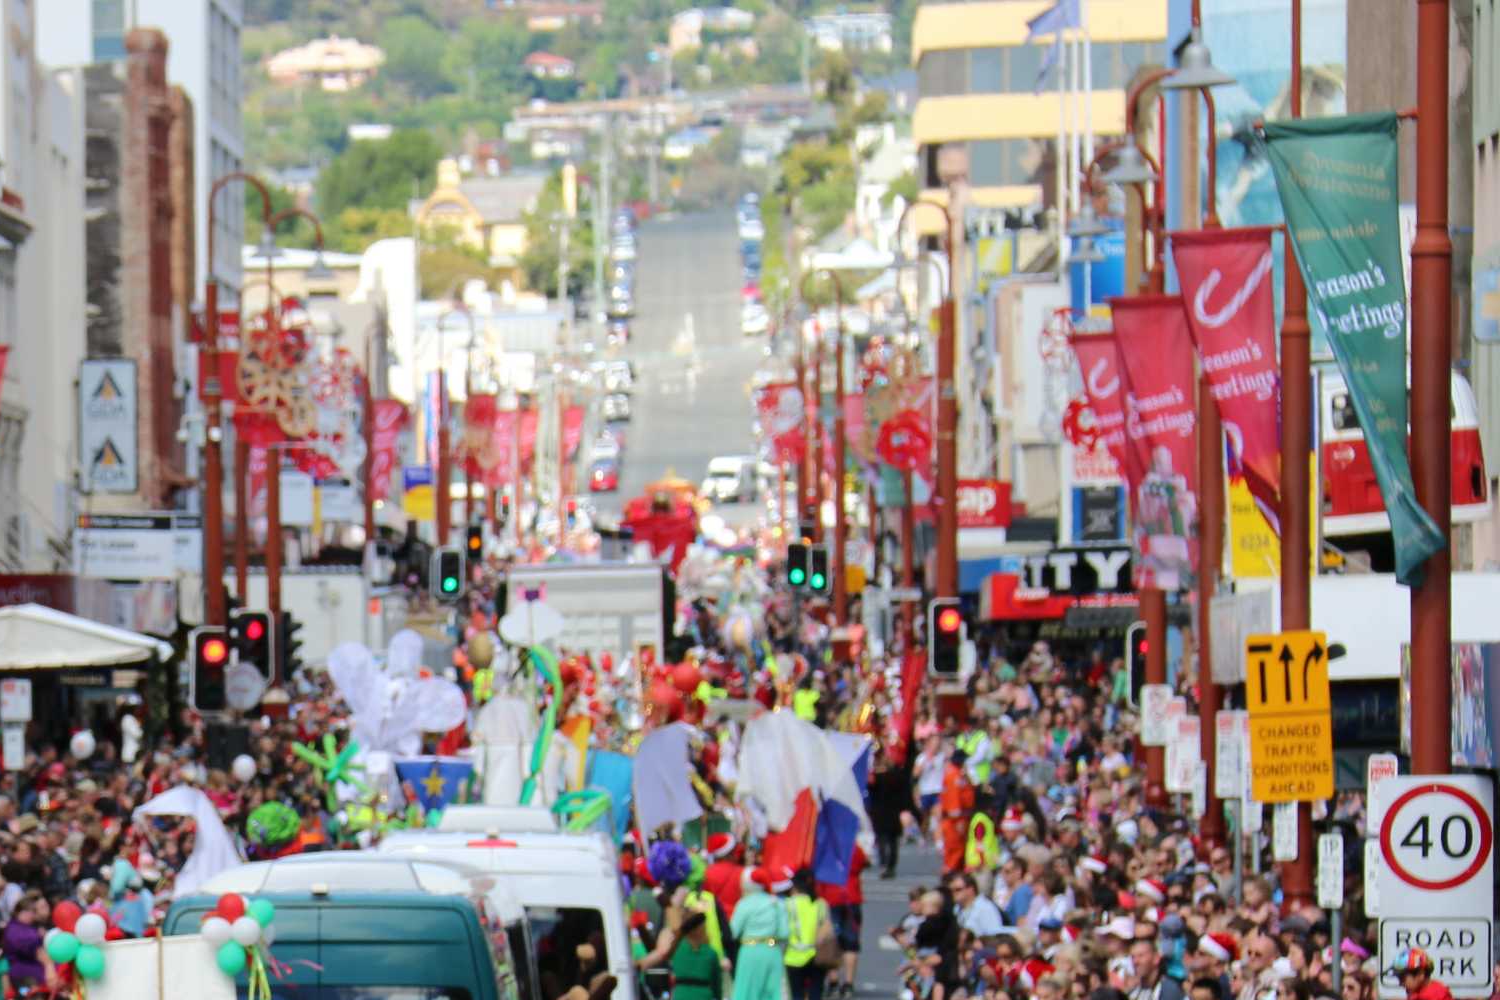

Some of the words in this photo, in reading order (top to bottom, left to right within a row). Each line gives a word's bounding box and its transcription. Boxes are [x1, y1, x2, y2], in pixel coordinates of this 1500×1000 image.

[1308, 258, 1386, 300] eason's
[1400, 814, 1474, 859] 40
[1396, 929, 1477, 949] ROAD
